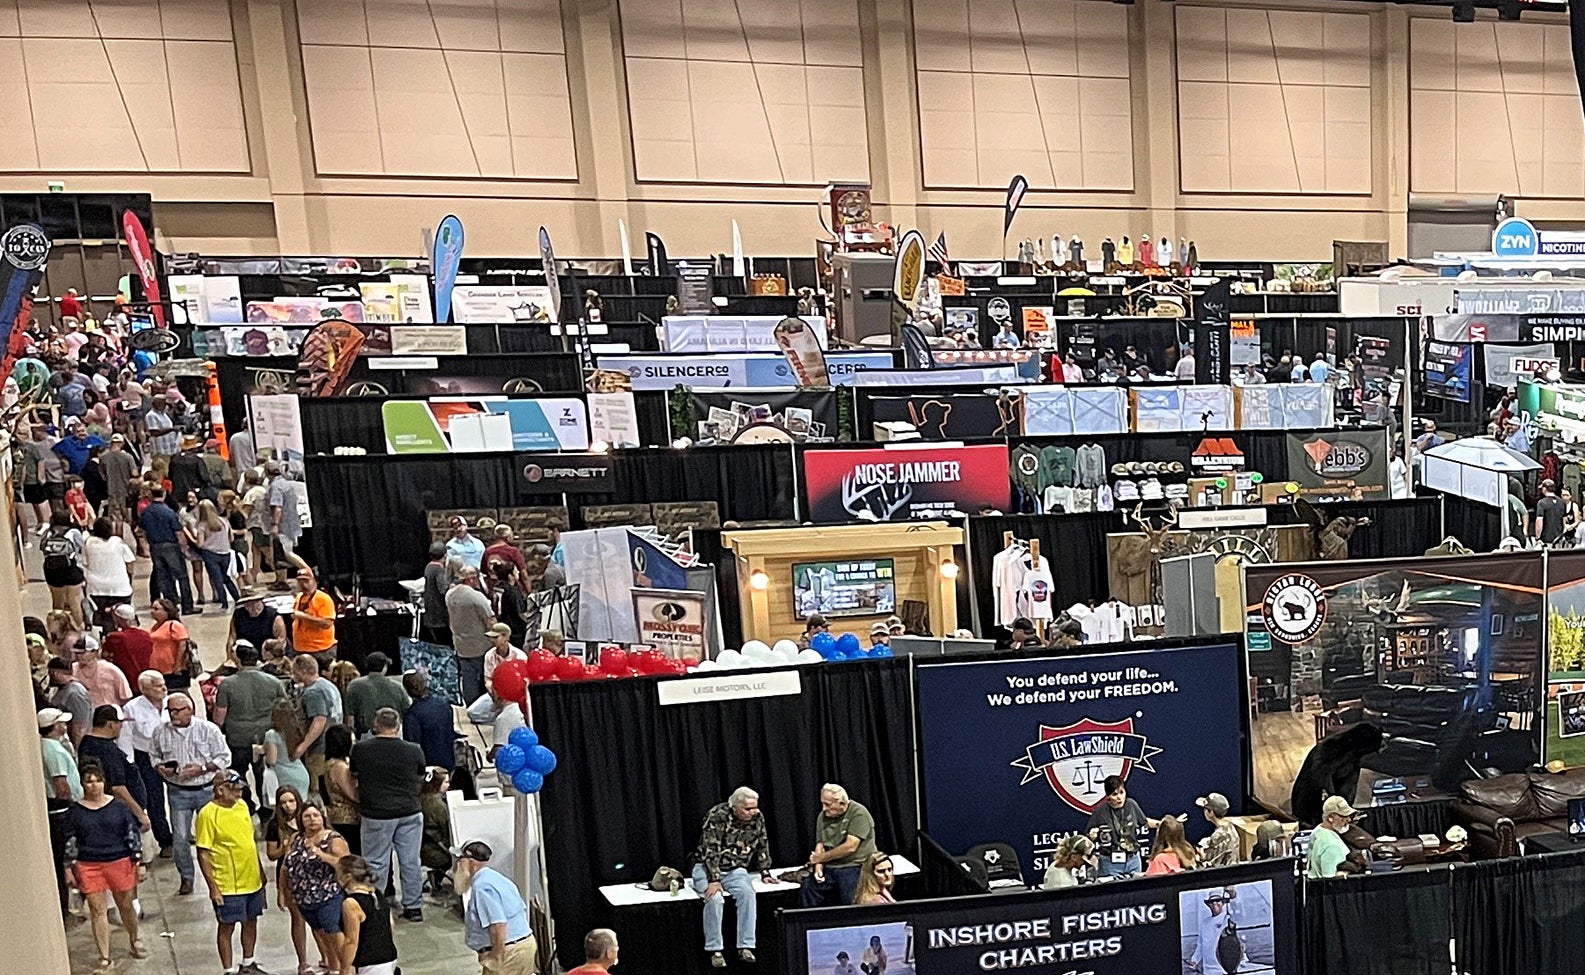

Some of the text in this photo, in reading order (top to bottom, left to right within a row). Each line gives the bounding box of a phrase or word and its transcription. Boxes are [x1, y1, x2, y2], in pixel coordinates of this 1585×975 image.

[1501, 235, 1531, 249] ZYN
[1397, 306, 1422, 315] SCI
[855, 461, 961, 484] NOSE JAMMER
[1566, 619, 1585, 629] Your
[1007, 667, 1160, 689] You defend your life...
[987, 681, 1178, 706] We defend your FREEDOM.
[1051, 741, 1070, 759] U.S.
[928, 903, 1167, 949] INSHORE FISHING
[979, 935, 1122, 970] CHARTERS
